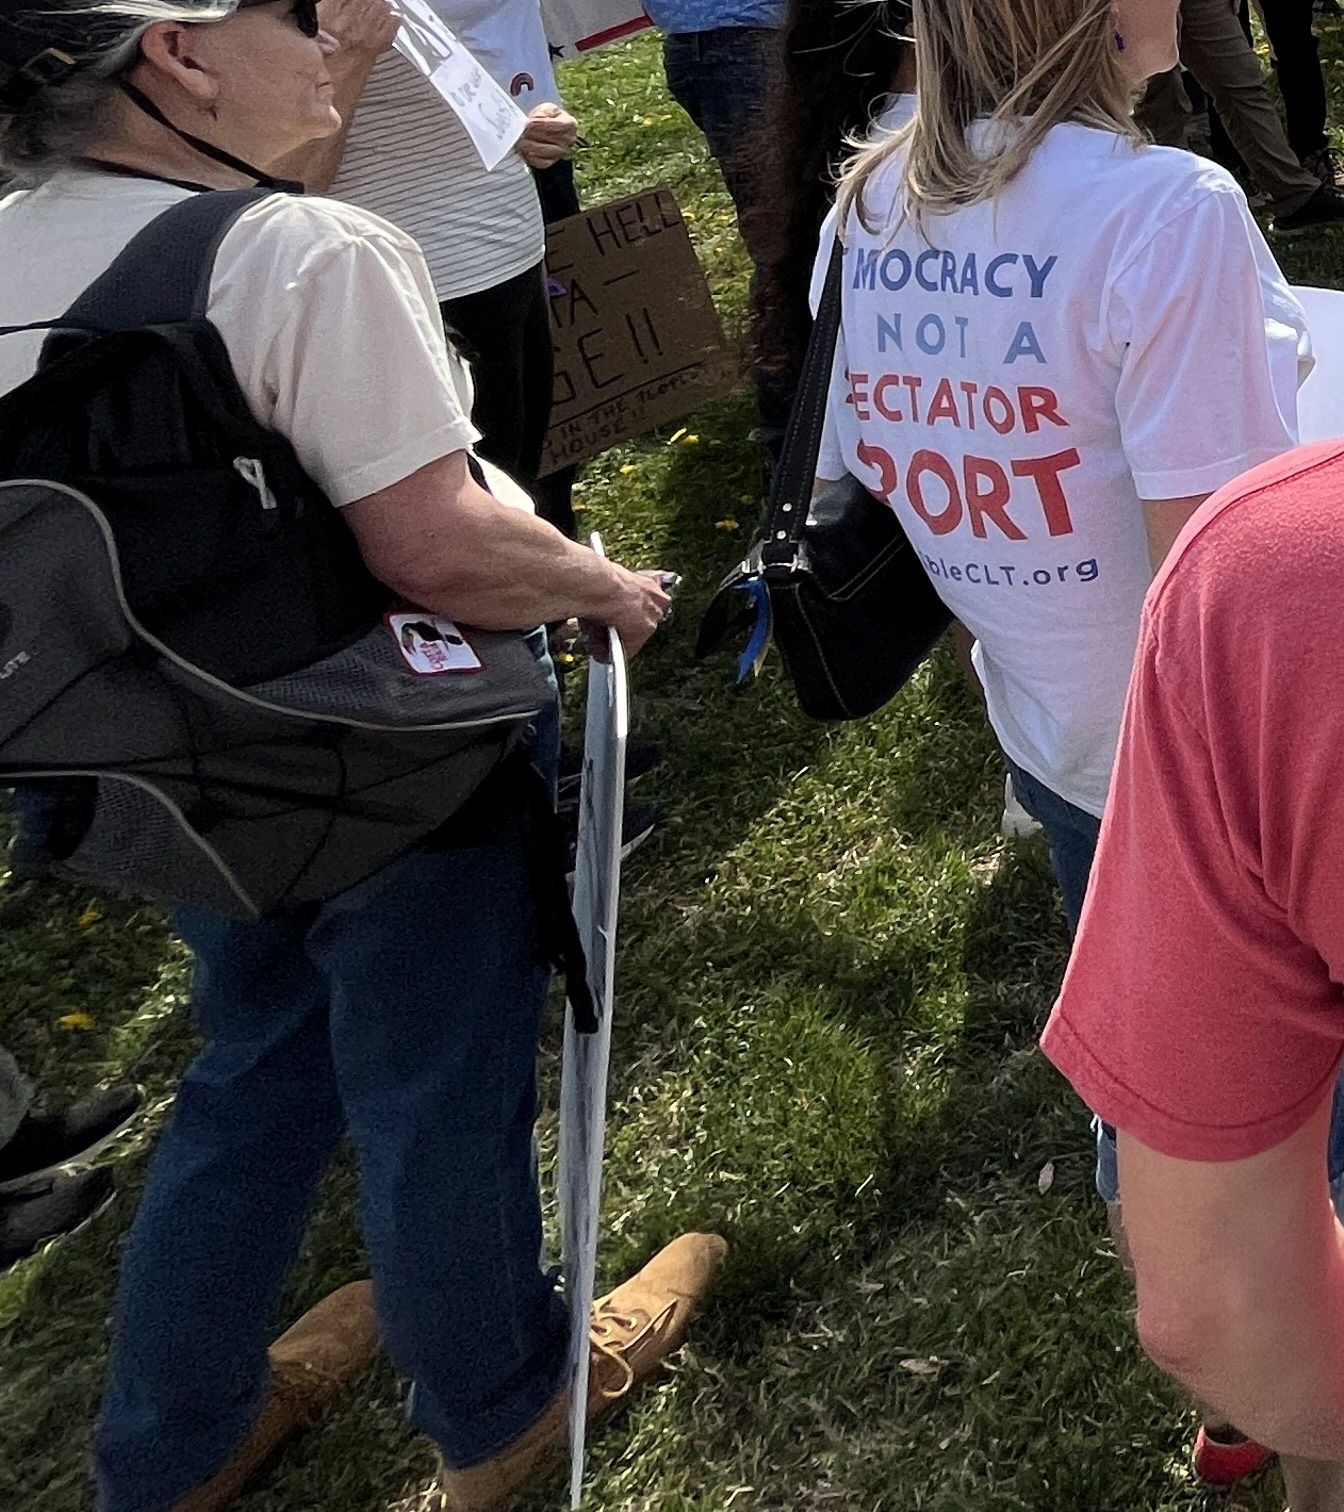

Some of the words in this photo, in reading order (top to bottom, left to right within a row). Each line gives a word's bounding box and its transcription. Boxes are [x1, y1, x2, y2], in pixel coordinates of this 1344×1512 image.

[586, 192, 681, 257] HELL
[841, 247, 1058, 299] MOCRACY
[877, 313, 968, 359] NOT
[1003, 321, 1047, 365] A
[845, 367, 1069, 436] ECTATOR
